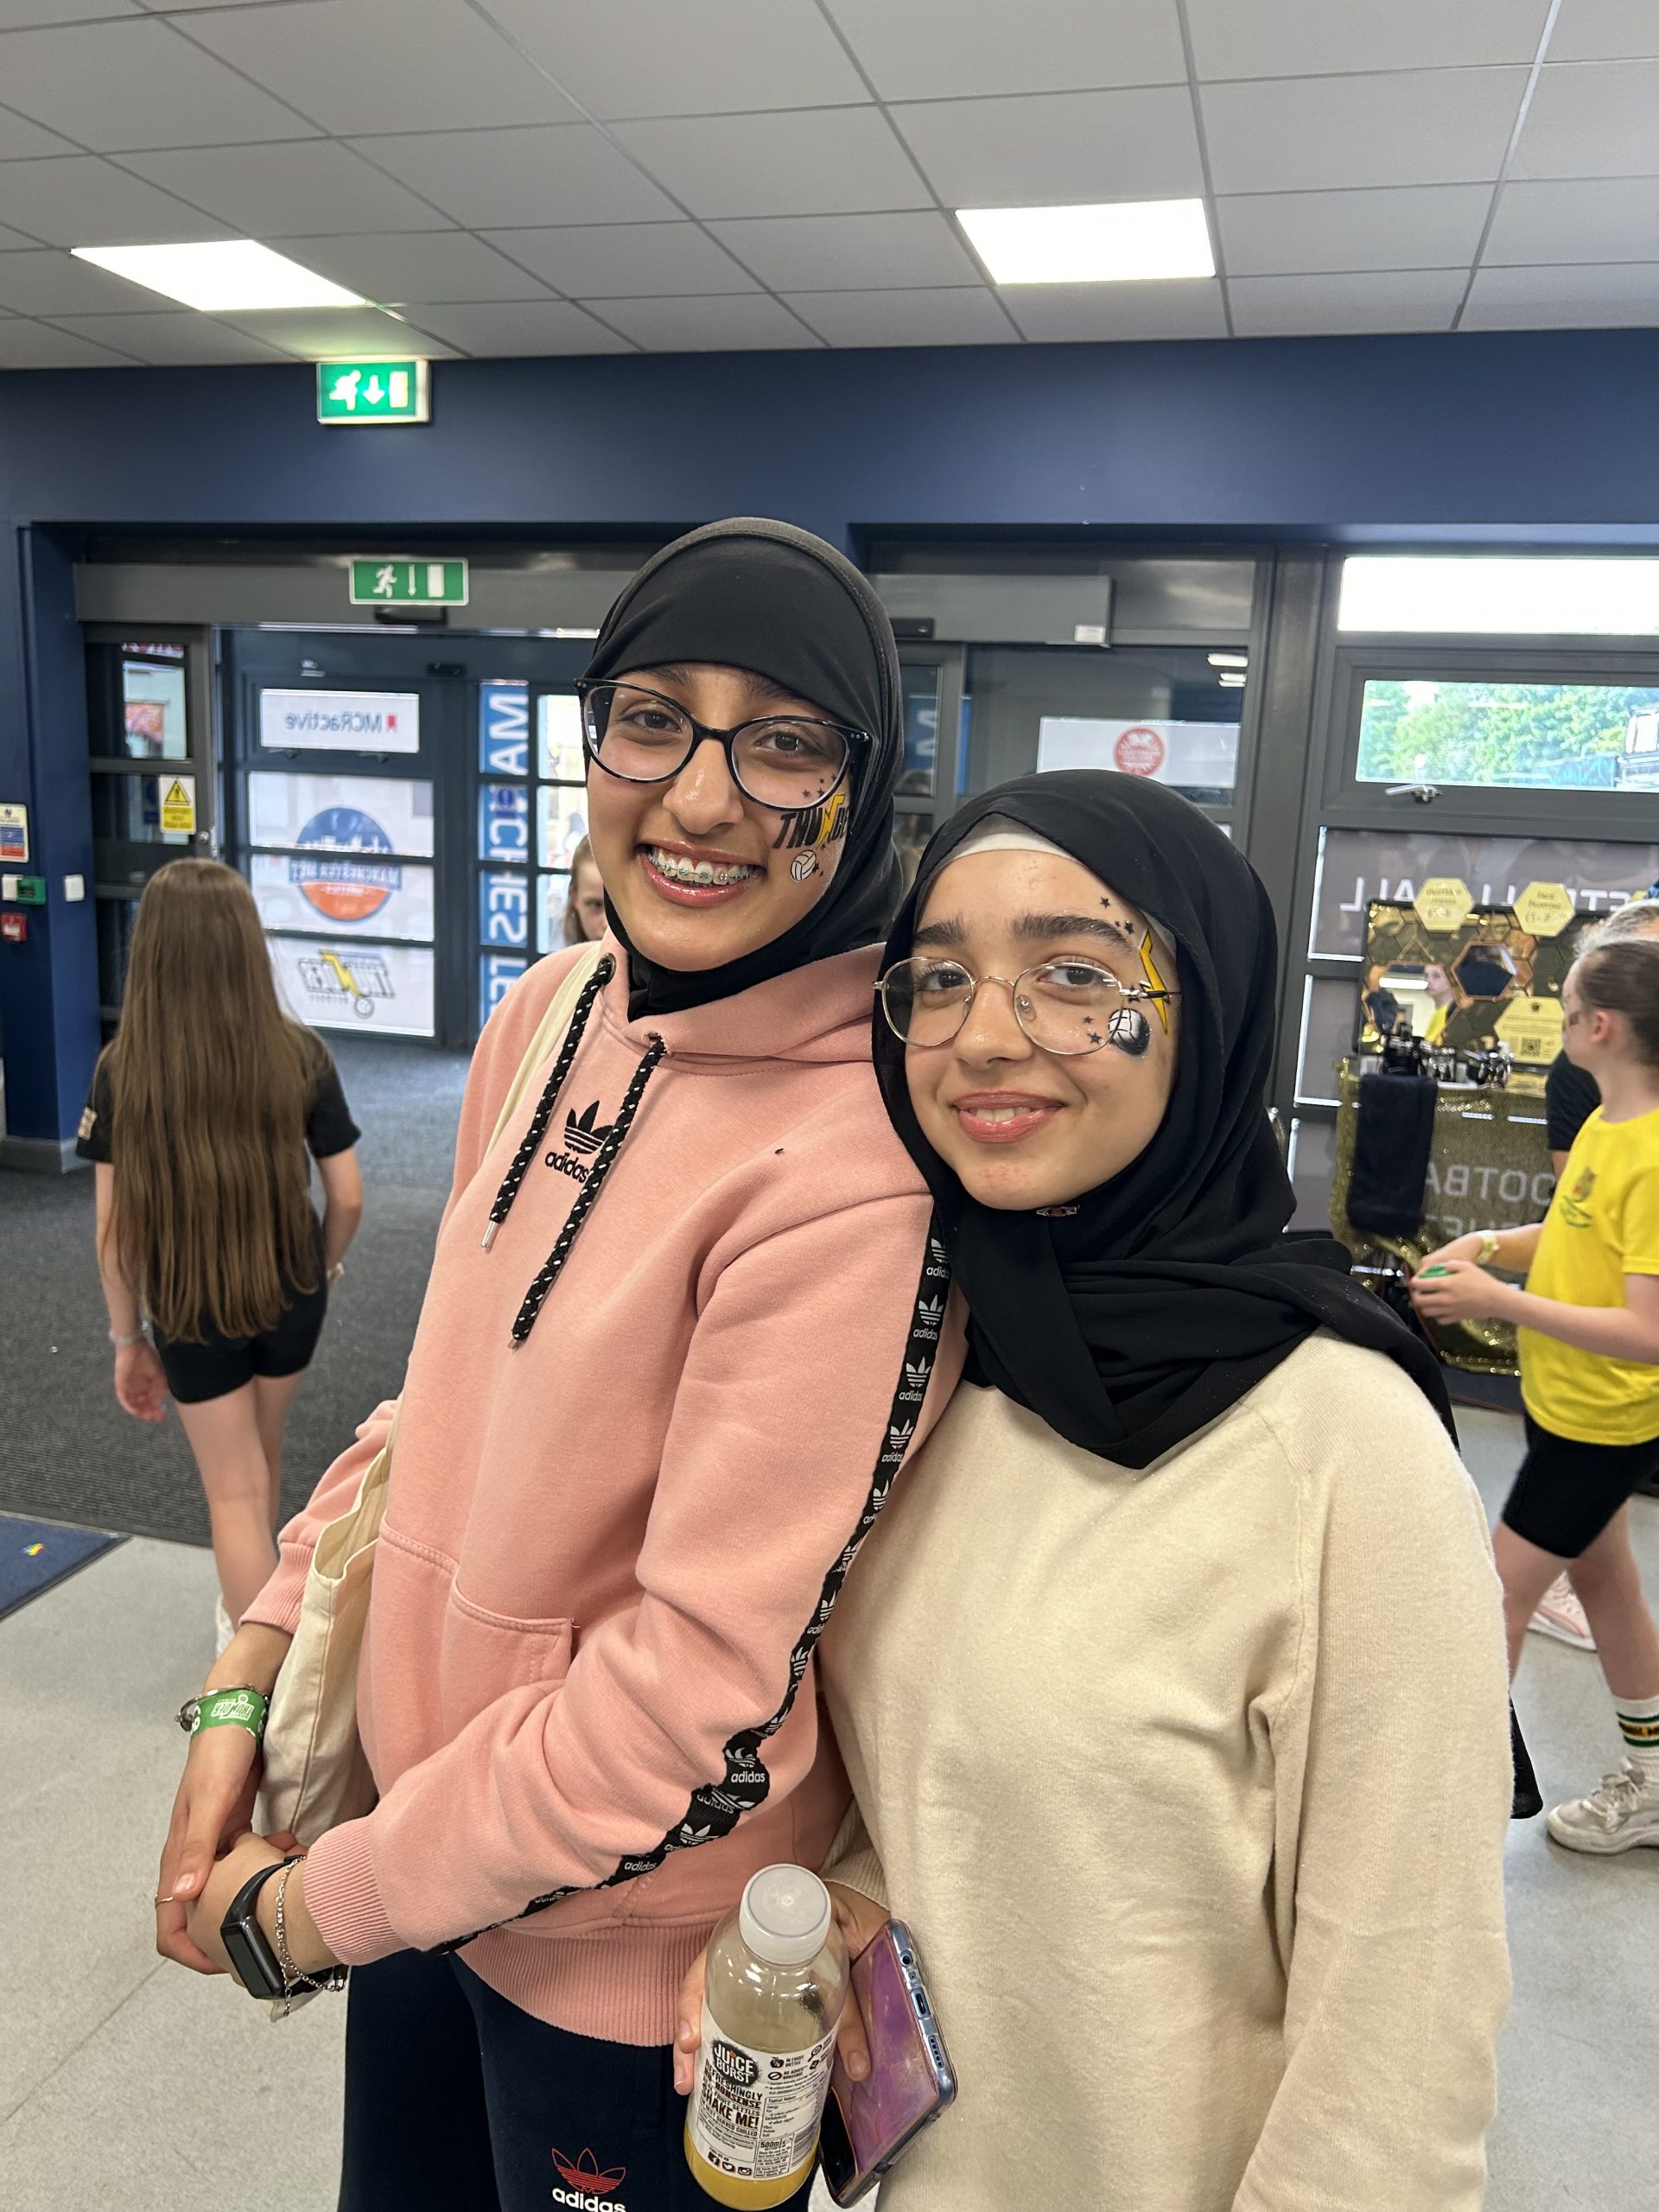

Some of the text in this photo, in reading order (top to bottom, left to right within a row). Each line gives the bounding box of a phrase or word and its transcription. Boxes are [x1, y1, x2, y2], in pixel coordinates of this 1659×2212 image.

[545, 1151, 589, 1183] adidas
[913, 1328, 938, 1340] adidas
[899, 1390, 923, 1402] adidas
[881, 1452, 904, 1463] adidas
[731, 1770, 766, 1783] adidas
[624, 1860, 657, 1872] adidas
[706, 2058, 763, 2101] REFRESHINGLY
[716, 2060, 750, 2083] BURST
[702, 2082, 733, 2121] SHAKE
[735, 2112, 759, 2129] ME!
[715, 2082, 762, 2108] NONSENSE
[552, 2188, 626, 2212] adidas
